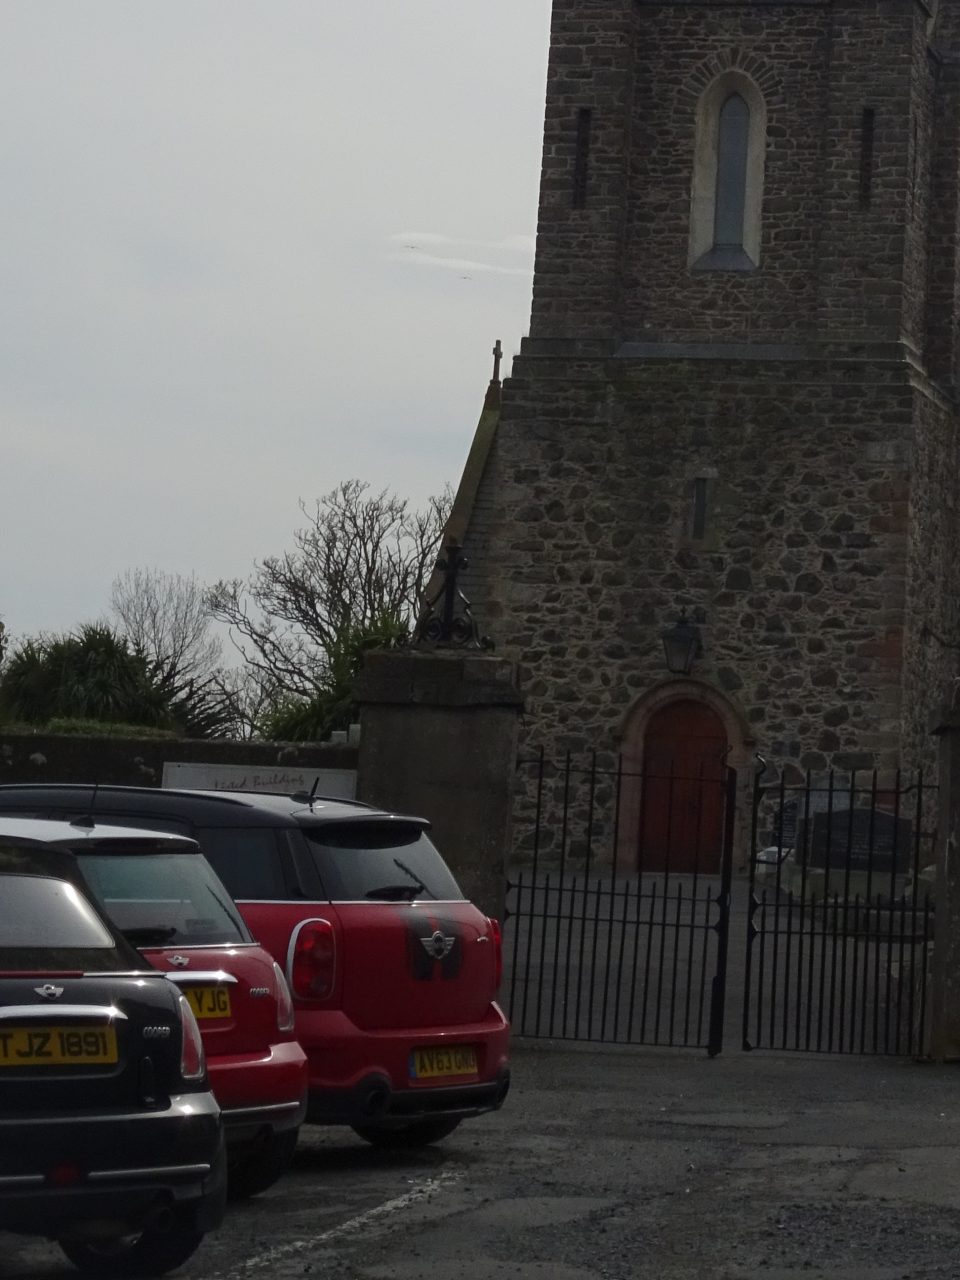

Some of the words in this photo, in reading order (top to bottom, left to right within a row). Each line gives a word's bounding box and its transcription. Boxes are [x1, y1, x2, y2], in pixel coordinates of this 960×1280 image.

[193, 990, 228, 1013] YJG
[57, 1030, 109, 1057] 1891
[142, 1026, 171, 1038] COOPER
